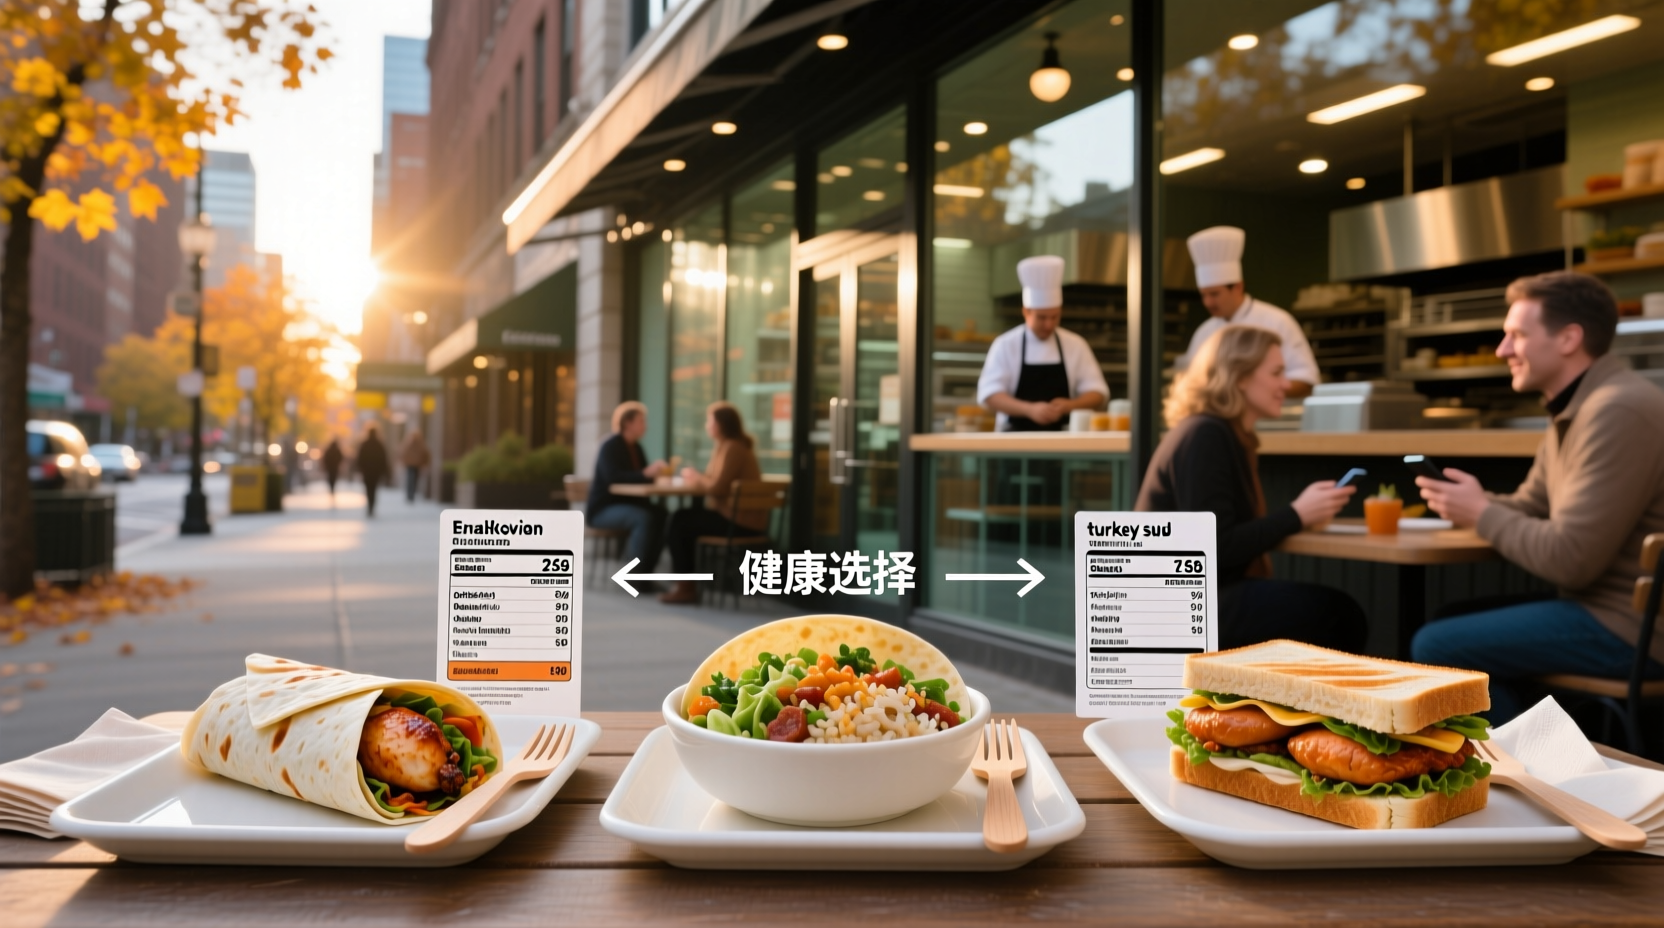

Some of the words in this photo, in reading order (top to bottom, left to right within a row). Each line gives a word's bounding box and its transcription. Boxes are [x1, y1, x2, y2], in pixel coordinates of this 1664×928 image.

[1087, 520, 1140, 541] turkey
[1142, 521, 1172, 537] sud
[542, 558, 570, 572] 259
